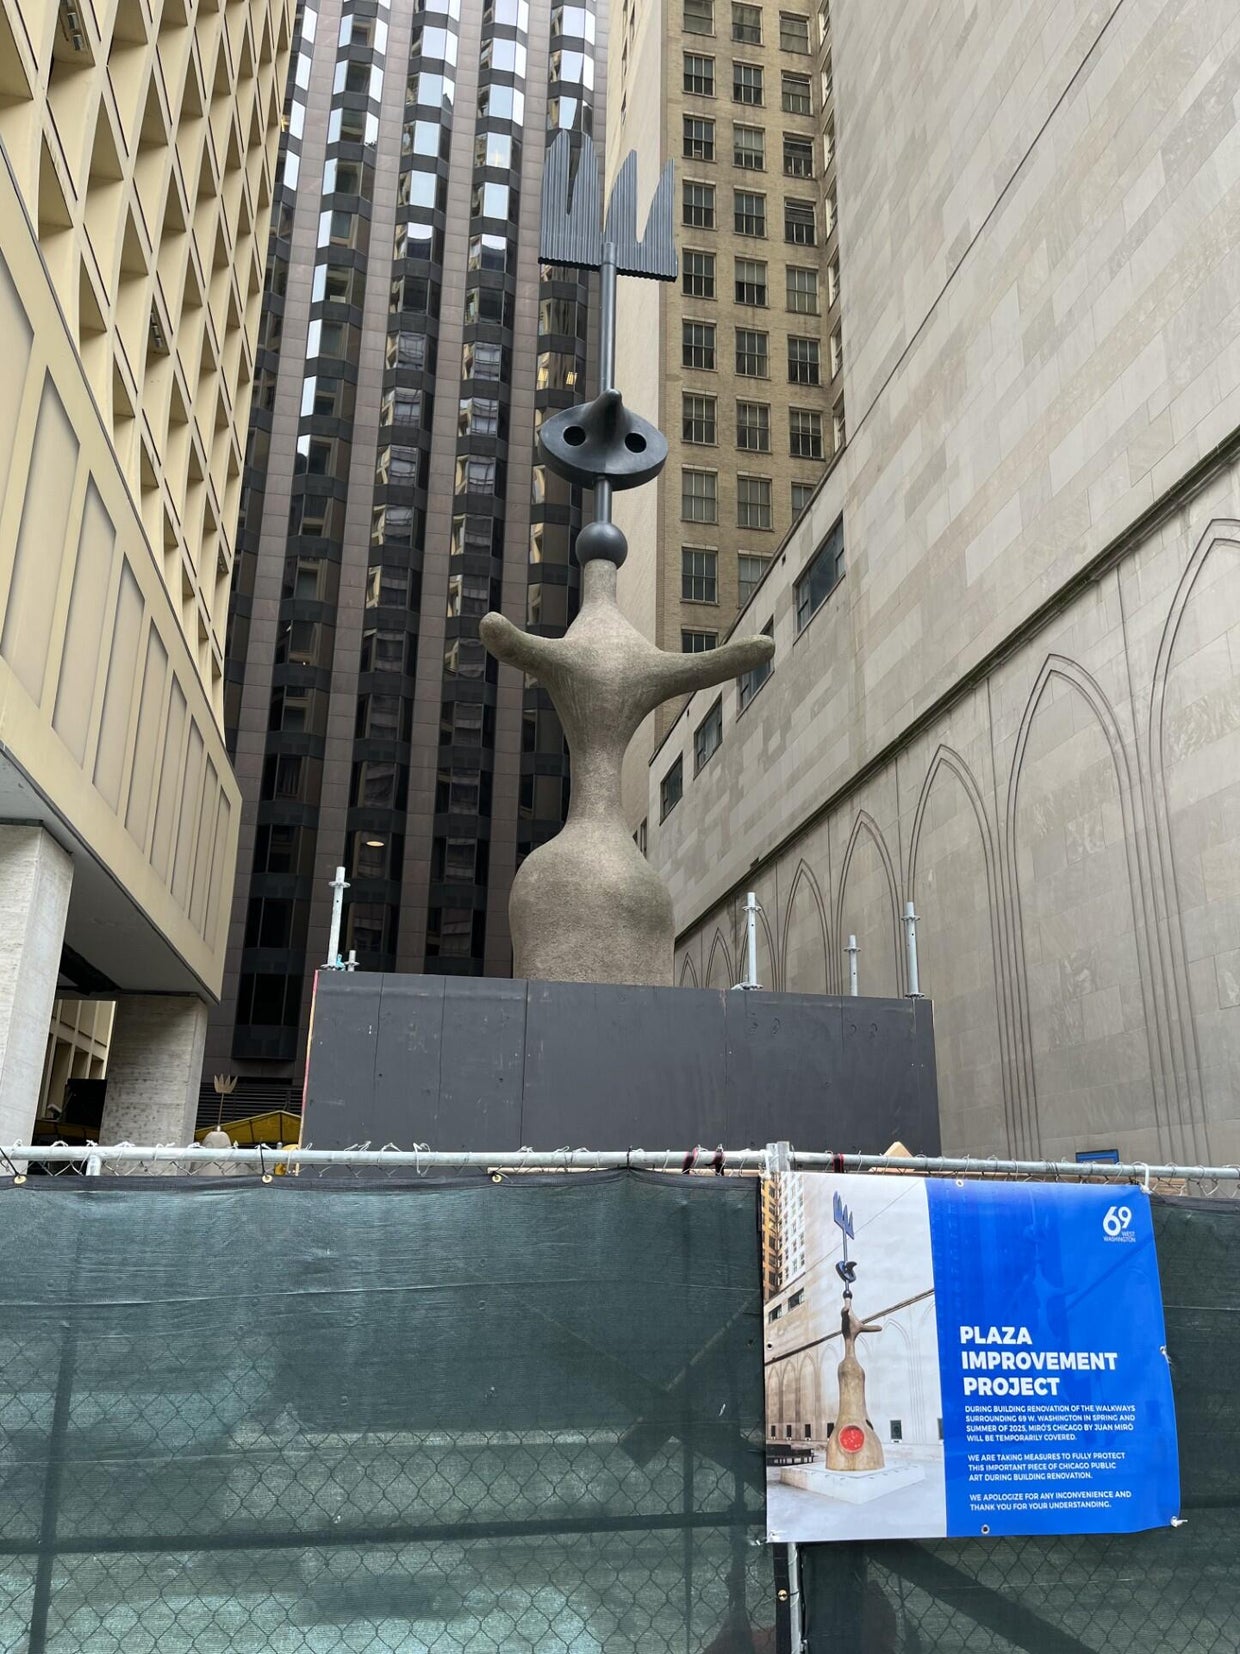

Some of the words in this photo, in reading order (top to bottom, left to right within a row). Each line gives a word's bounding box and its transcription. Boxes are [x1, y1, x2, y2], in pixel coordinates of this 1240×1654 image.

[1102, 1206, 1132, 1236] 69
[960, 1326, 1032, 1344] PLAZA
[962, 1351, 1118, 1370] IMPROVEMENT
[964, 1377, 1060, 1396] PROJECT
[1114, 1422, 1134, 1431] MIRÓ
[1055, 1491, 1114, 1499] INCONVENIENCE
[1049, 1501, 1112, 1509] UNDERSTANDING.
